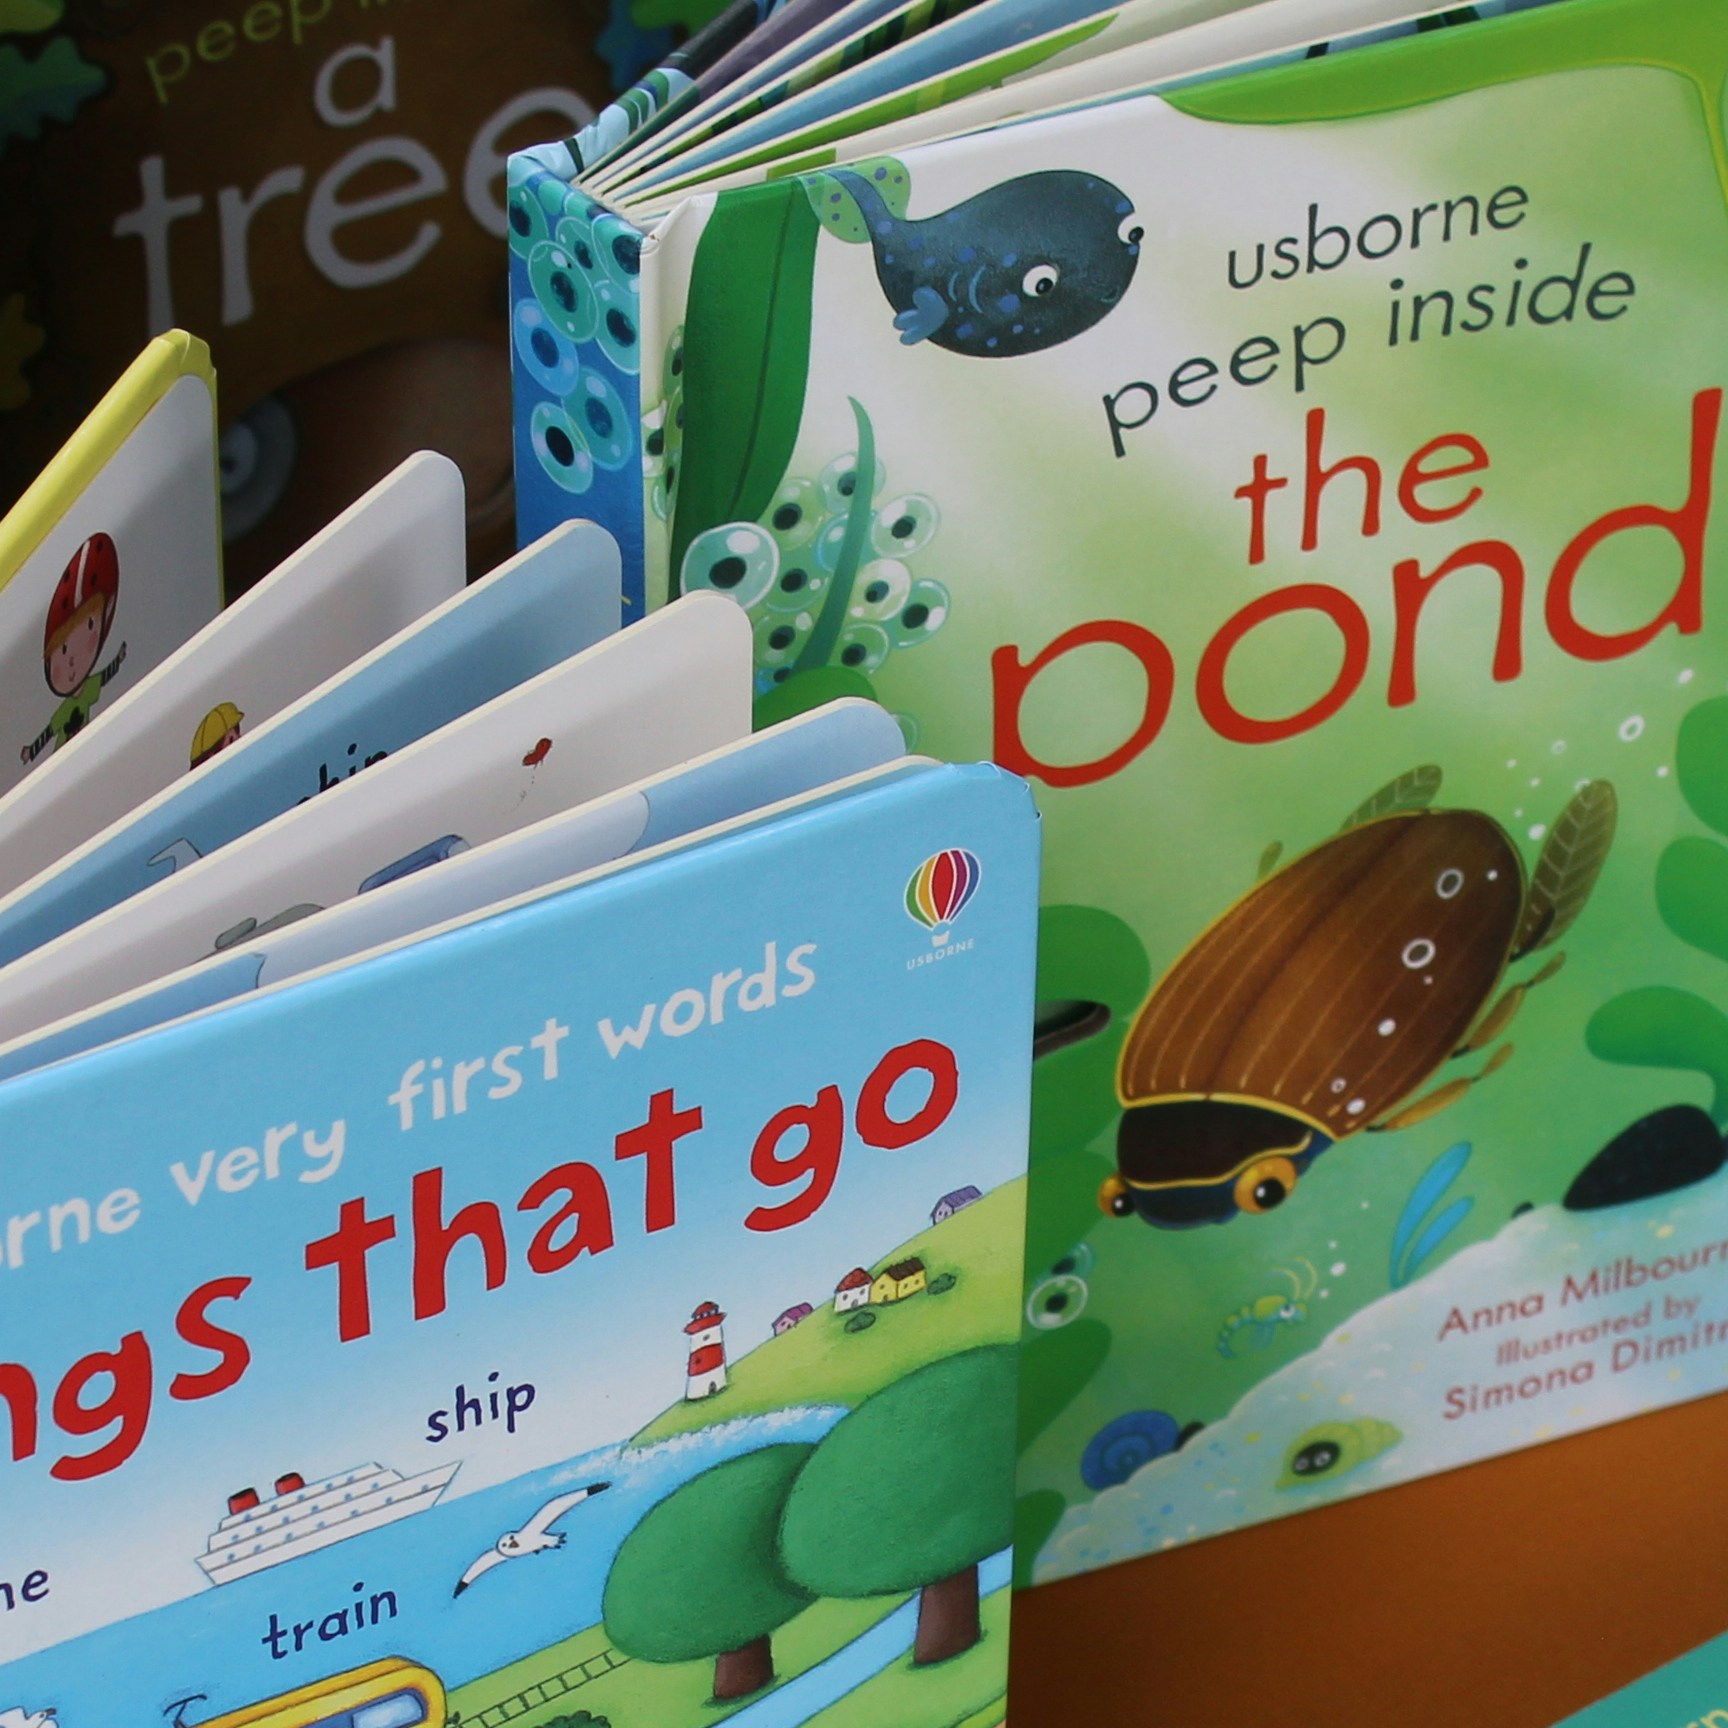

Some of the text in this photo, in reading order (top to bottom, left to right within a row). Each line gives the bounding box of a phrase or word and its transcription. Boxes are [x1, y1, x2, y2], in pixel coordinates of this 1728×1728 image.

[314, 35, 396, 128] a
[113, 87, 600, 335] tree
[1225, 183, 1530, 291] usborne
[1101, 242, 1636, 458] peep inside
[1233, 406, 1490, 566] the
[989, 386, 1723, 789] pond
[905, 937, 976, 971] USBORNE
[168, 1117, 348, 1207] very
[387, 1016, 571, 1132] first
[597, 940, 819, 1060] words
[304, 1086, 703, 1344] that
[744, 1037, 960, 1233] go
[1436, 1289, 1545, 1341] Anna
[1494, 1289, 1703, 1368] Illustrated by
[425, 1371, 537, 1443] ship
[1442, 1359, 1595, 1422] Simona
[260, 1581, 400, 1661] train
